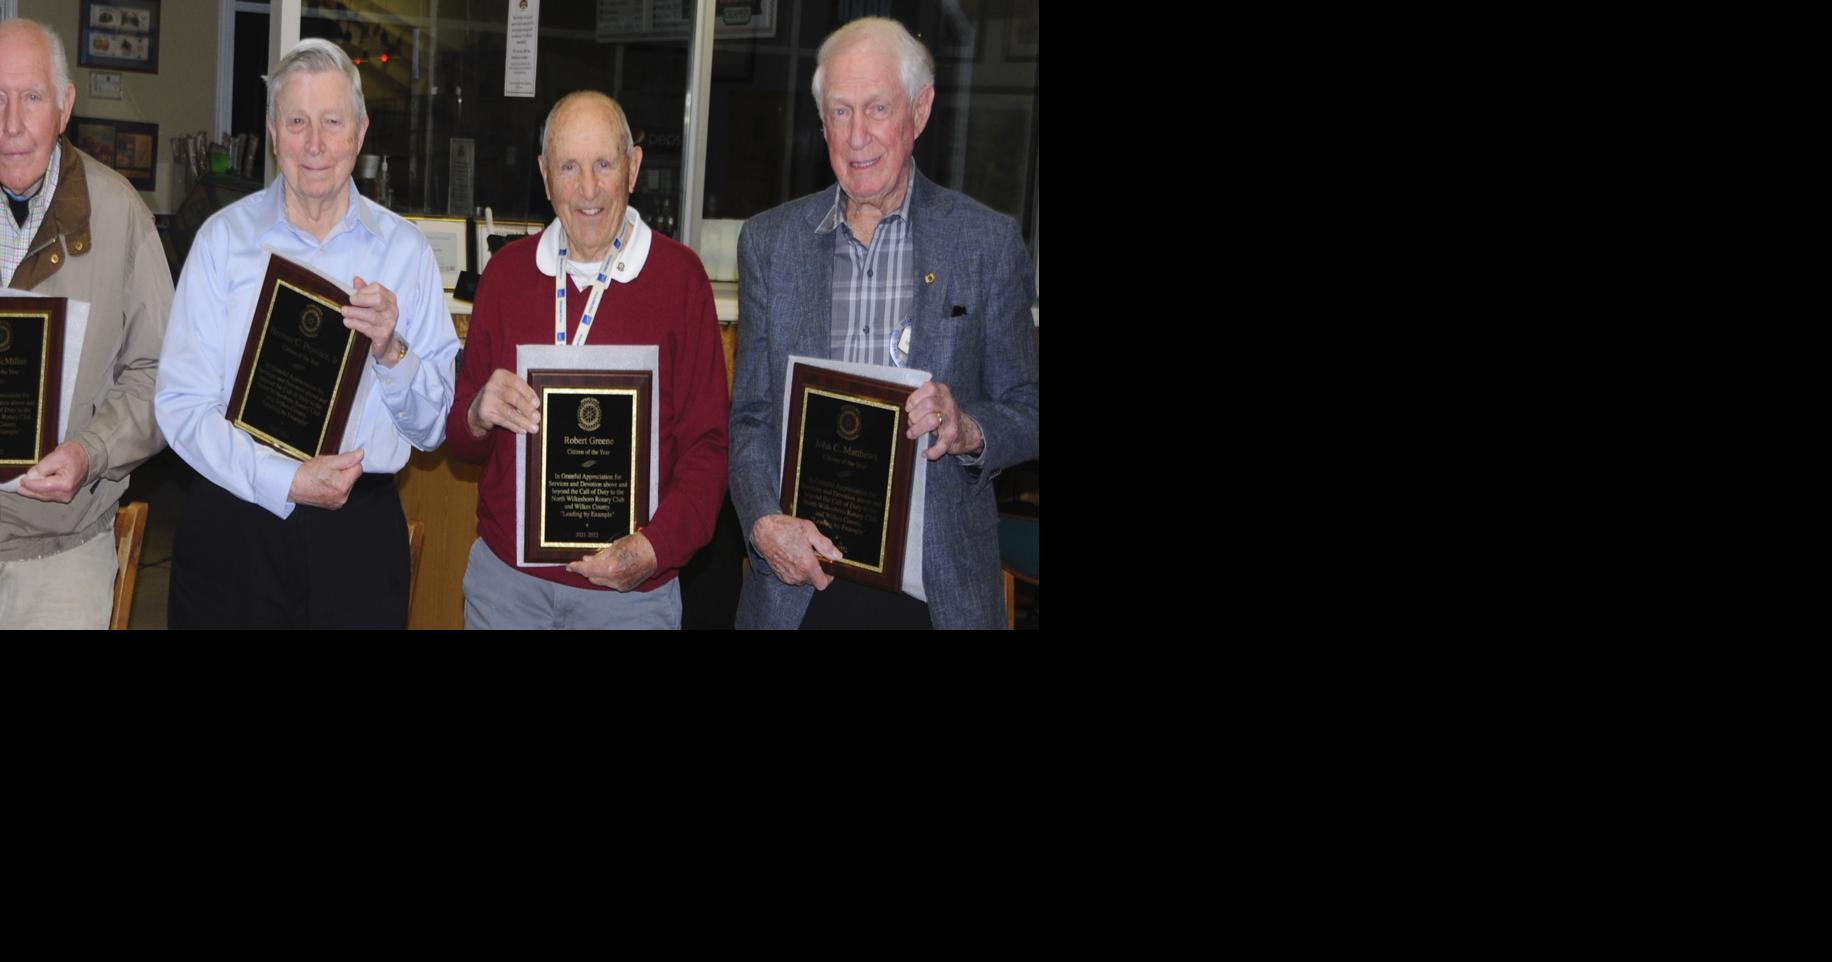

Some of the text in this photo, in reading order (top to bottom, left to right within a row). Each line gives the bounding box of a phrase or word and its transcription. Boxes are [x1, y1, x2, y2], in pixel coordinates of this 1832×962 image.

[564, 435, 614, 446] Robert Greene
[582, 472, 613, 481] Appreciation
[597, 489, 609, 497] Duty
[595, 496, 611, 504] Rotary
[592, 503, 610, 511] County
[583, 511, 589, 519] by
